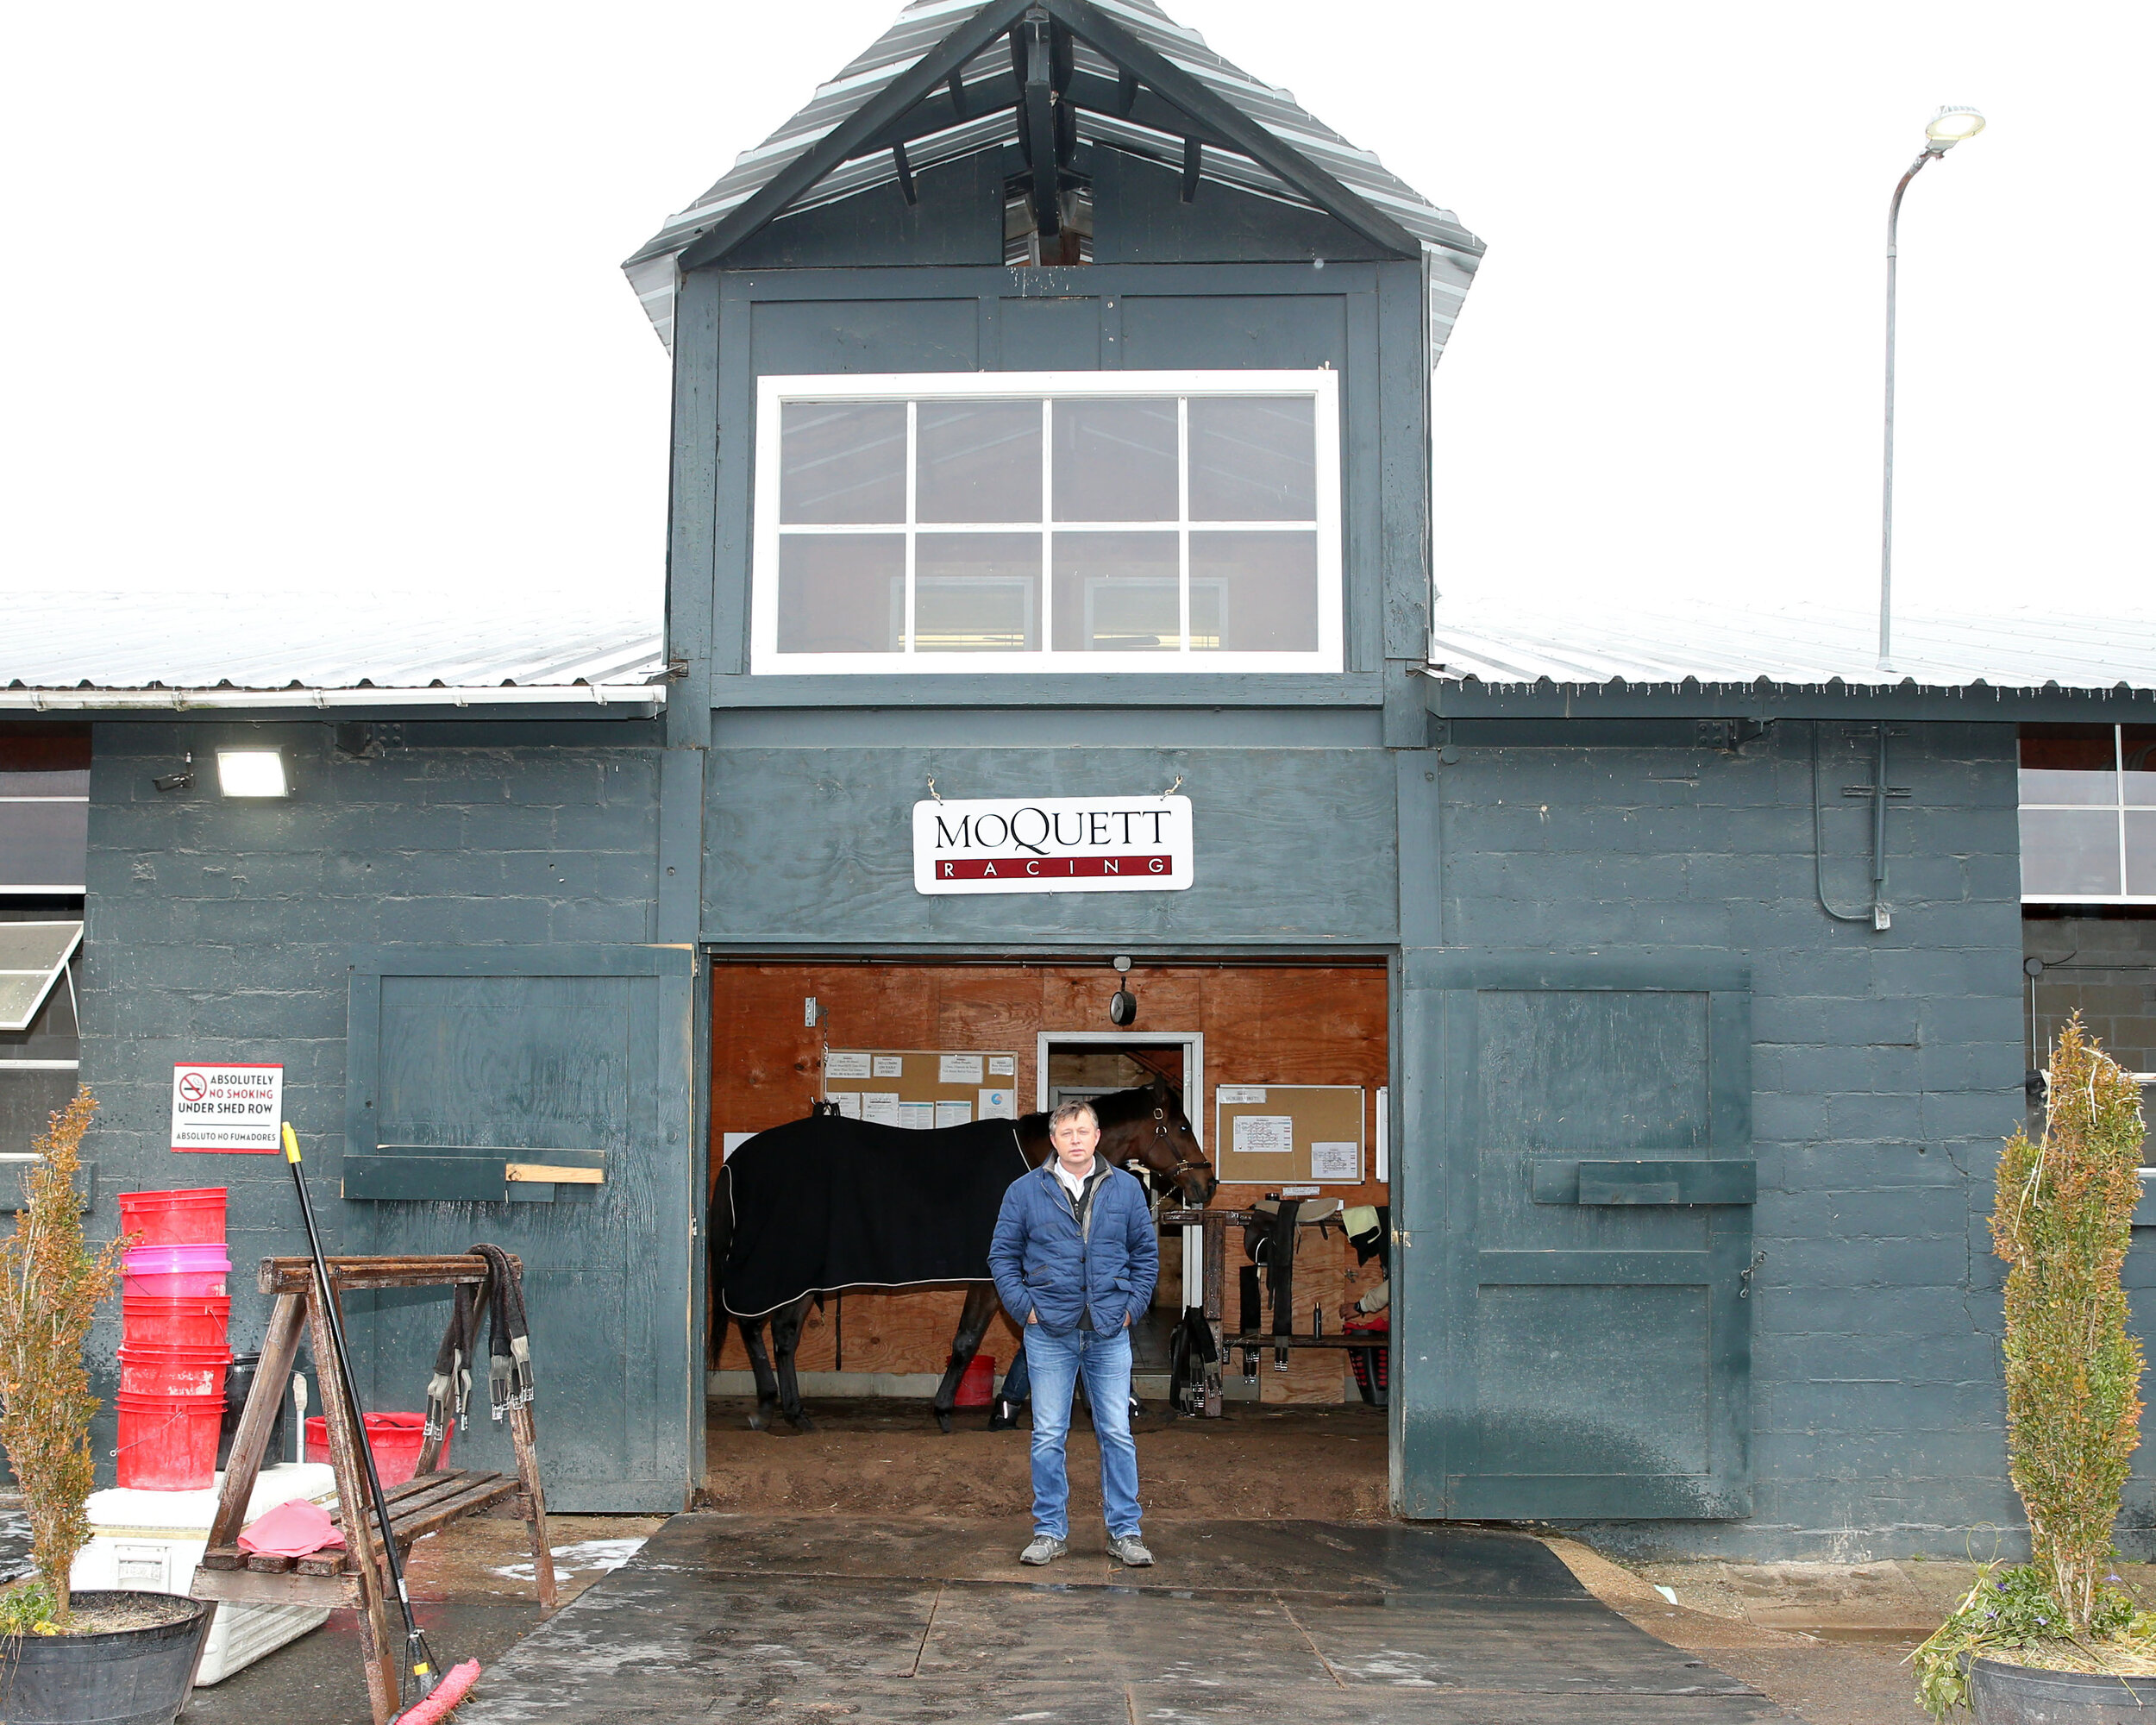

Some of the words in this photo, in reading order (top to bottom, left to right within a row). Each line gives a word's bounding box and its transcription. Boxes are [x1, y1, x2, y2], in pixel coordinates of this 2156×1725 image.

[935, 807, 1172, 855] MOQUETT
[943, 858, 1164, 877] RACING
[210, 1075, 274, 1085] ABSOLUTELY
[210, 1088, 223, 1099] NO
[227, 1089, 273, 1100] SMOKING
[179, 1102, 215, 1113] UNDER
[216, 1103, 245, 1114] SHED
[248, 1104, 273, 1114] ROW
[176, 1132, 216, 1140] ABSOLUTO
[230, 1133, 276, 1142] FUMADORES
